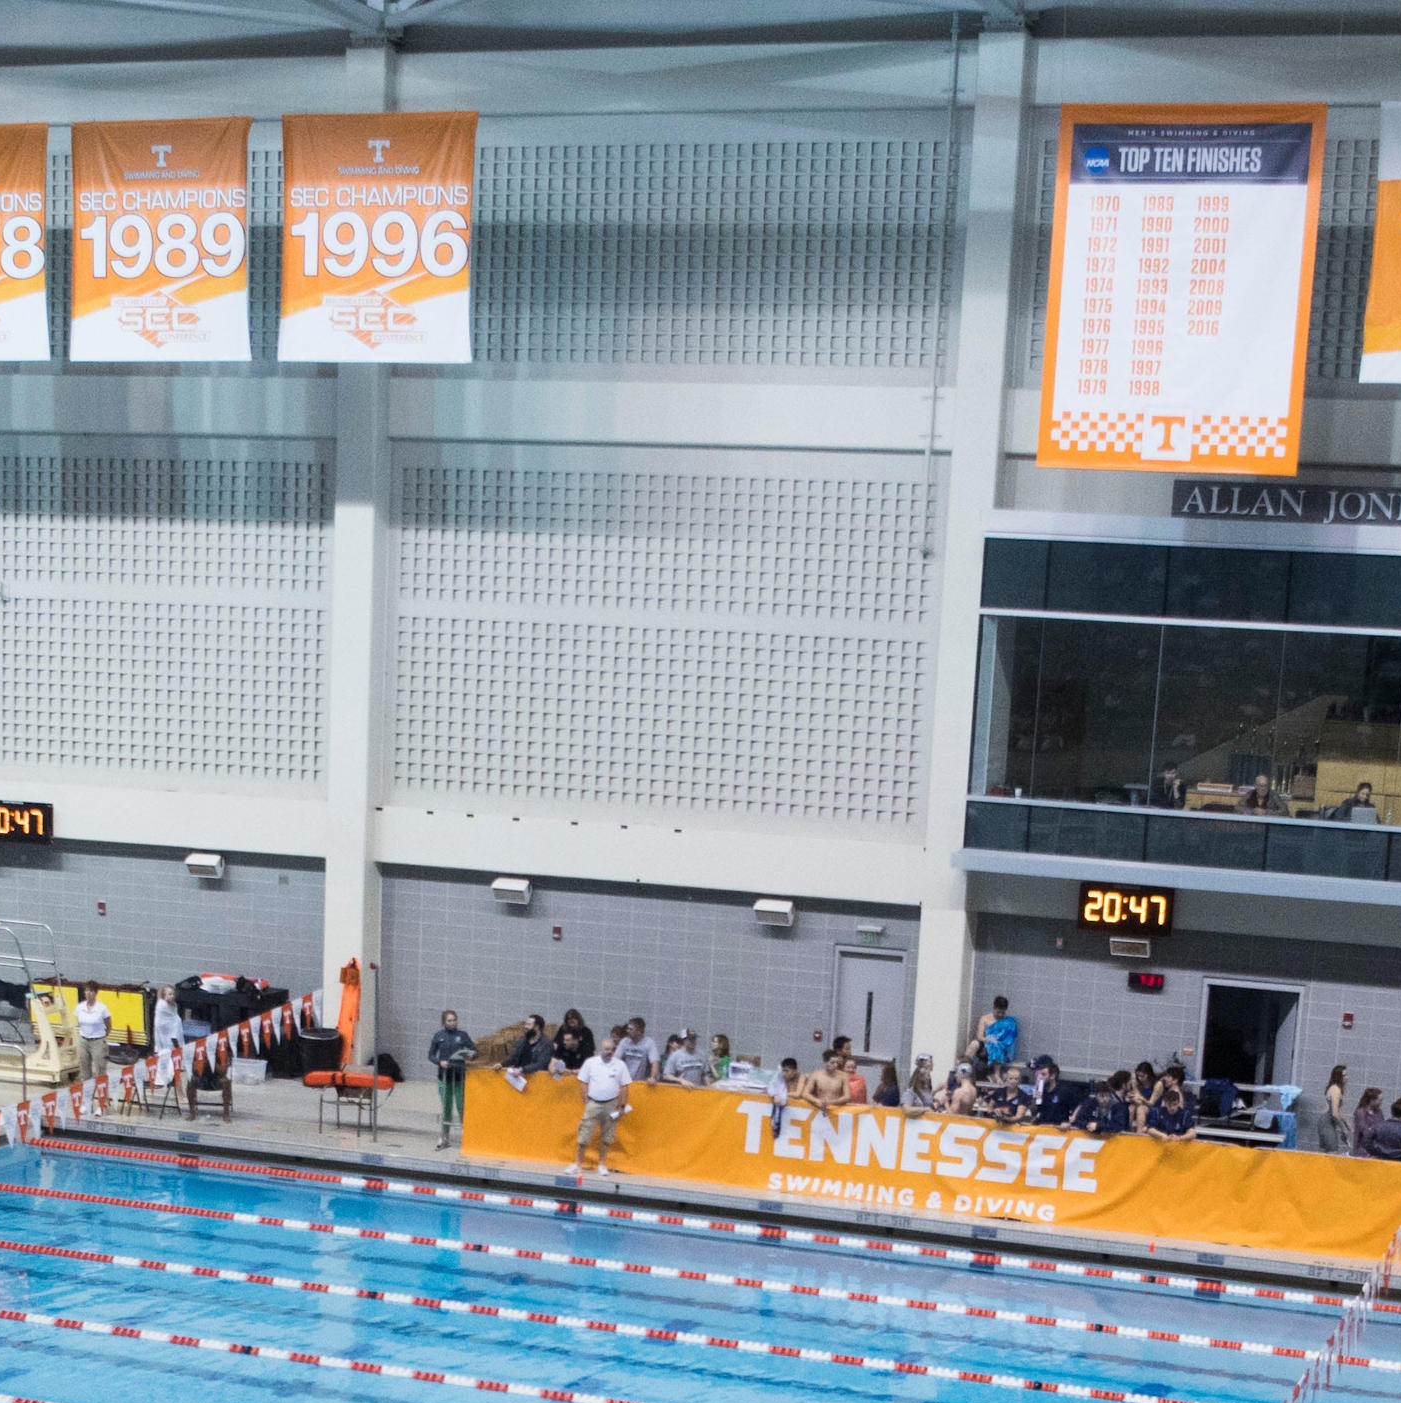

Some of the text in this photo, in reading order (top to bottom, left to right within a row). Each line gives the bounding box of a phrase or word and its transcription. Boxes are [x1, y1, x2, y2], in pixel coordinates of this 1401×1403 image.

[151, 145, 172, 168] T
[368, 139, 391, 163] T
[1118, 146, 1263, 173] TOP TEN FINISHES
[79, 188, 246, 212] SEC CHAMPIONS
[291, 185, 468, 208] SEC CHAMPIONS
[1090, 195, 1120, 212] 1970
[1142, 195, 1175, 212] 1989
[1090, 216, 1118, 233] 1971
[1194, 216, 1229, 233] 2000
[80, 211, 247, 279] 1989
[291, 210, 469, 278] 1996
[1087, 236, 1117, 253] 1972
[1141, 237, 1170, 253] 1991
[1194, 237, 1227, 254] 2001
[1086, 256, 1116, 273] 1973
[1138, 257, 1169, 274] 1992
[1191, 258, 1226, 275] 2004
[1085, 277, 1113, 293] 1974
[1189, 279, 1224, 295] 2008
[1084, 298, 1112, 313] 1975
[1135, 298, 1166, 314] 1994
[1187, 299, 1222, 315] 2009
[119, 307, 200, 331] SEC
[331, 307, 417, 331] SEC
[1082, 318, 1110, 334] 1976
[1134, 319, 1164, 335] 1995
[1187, 320, 1219, 336] 2016
[1081, 338, 1109, 354] 1977
[1079, 359, 1108, 374] 1978
[1078, 378, 1107, 395] 1979
[1151, 415, 1186, 452] T
[1182, 485, 1307, 517] ALLAN
[1084, 890, 1167, 926] 20:47
[737, 1100, 1106, 1193] TENNESSEE
[768, 1172, 1056, 1222] SWIMMING & DIVING
